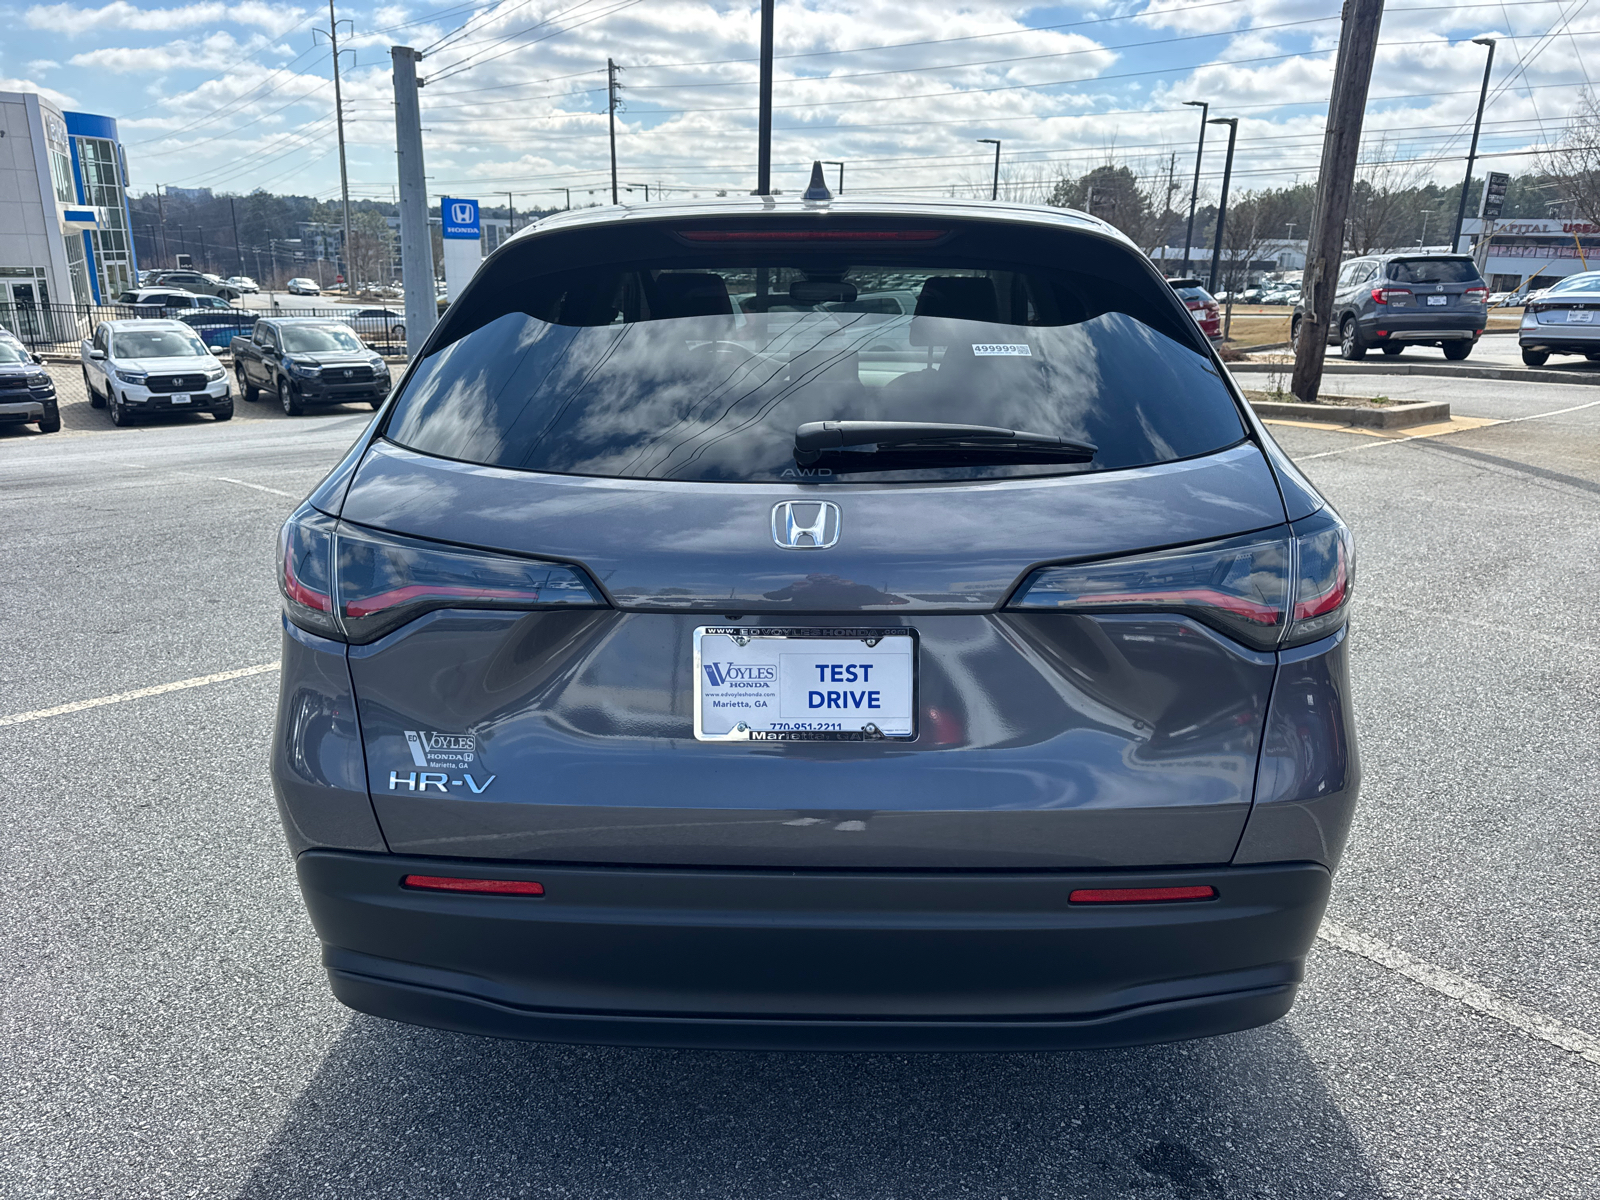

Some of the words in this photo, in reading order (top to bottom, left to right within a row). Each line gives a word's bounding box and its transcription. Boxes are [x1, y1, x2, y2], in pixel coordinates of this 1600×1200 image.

[780, 468, 832, 477] AWD
[712, 662, 774, 684] VOYLES
[816, 664, 873, 682] TEST
[713, 700, 752, 708] Marietta,
[808, 690, 880, 708] DRIVE
[770, 722, 842, 730] 770-951-2211
[419, 731, 474, 752] VOYLES
[752, 732, 830, 740] Marietta,
[836, 732, 862, 740] GA
[389, 771, 496, 793] HR-V
